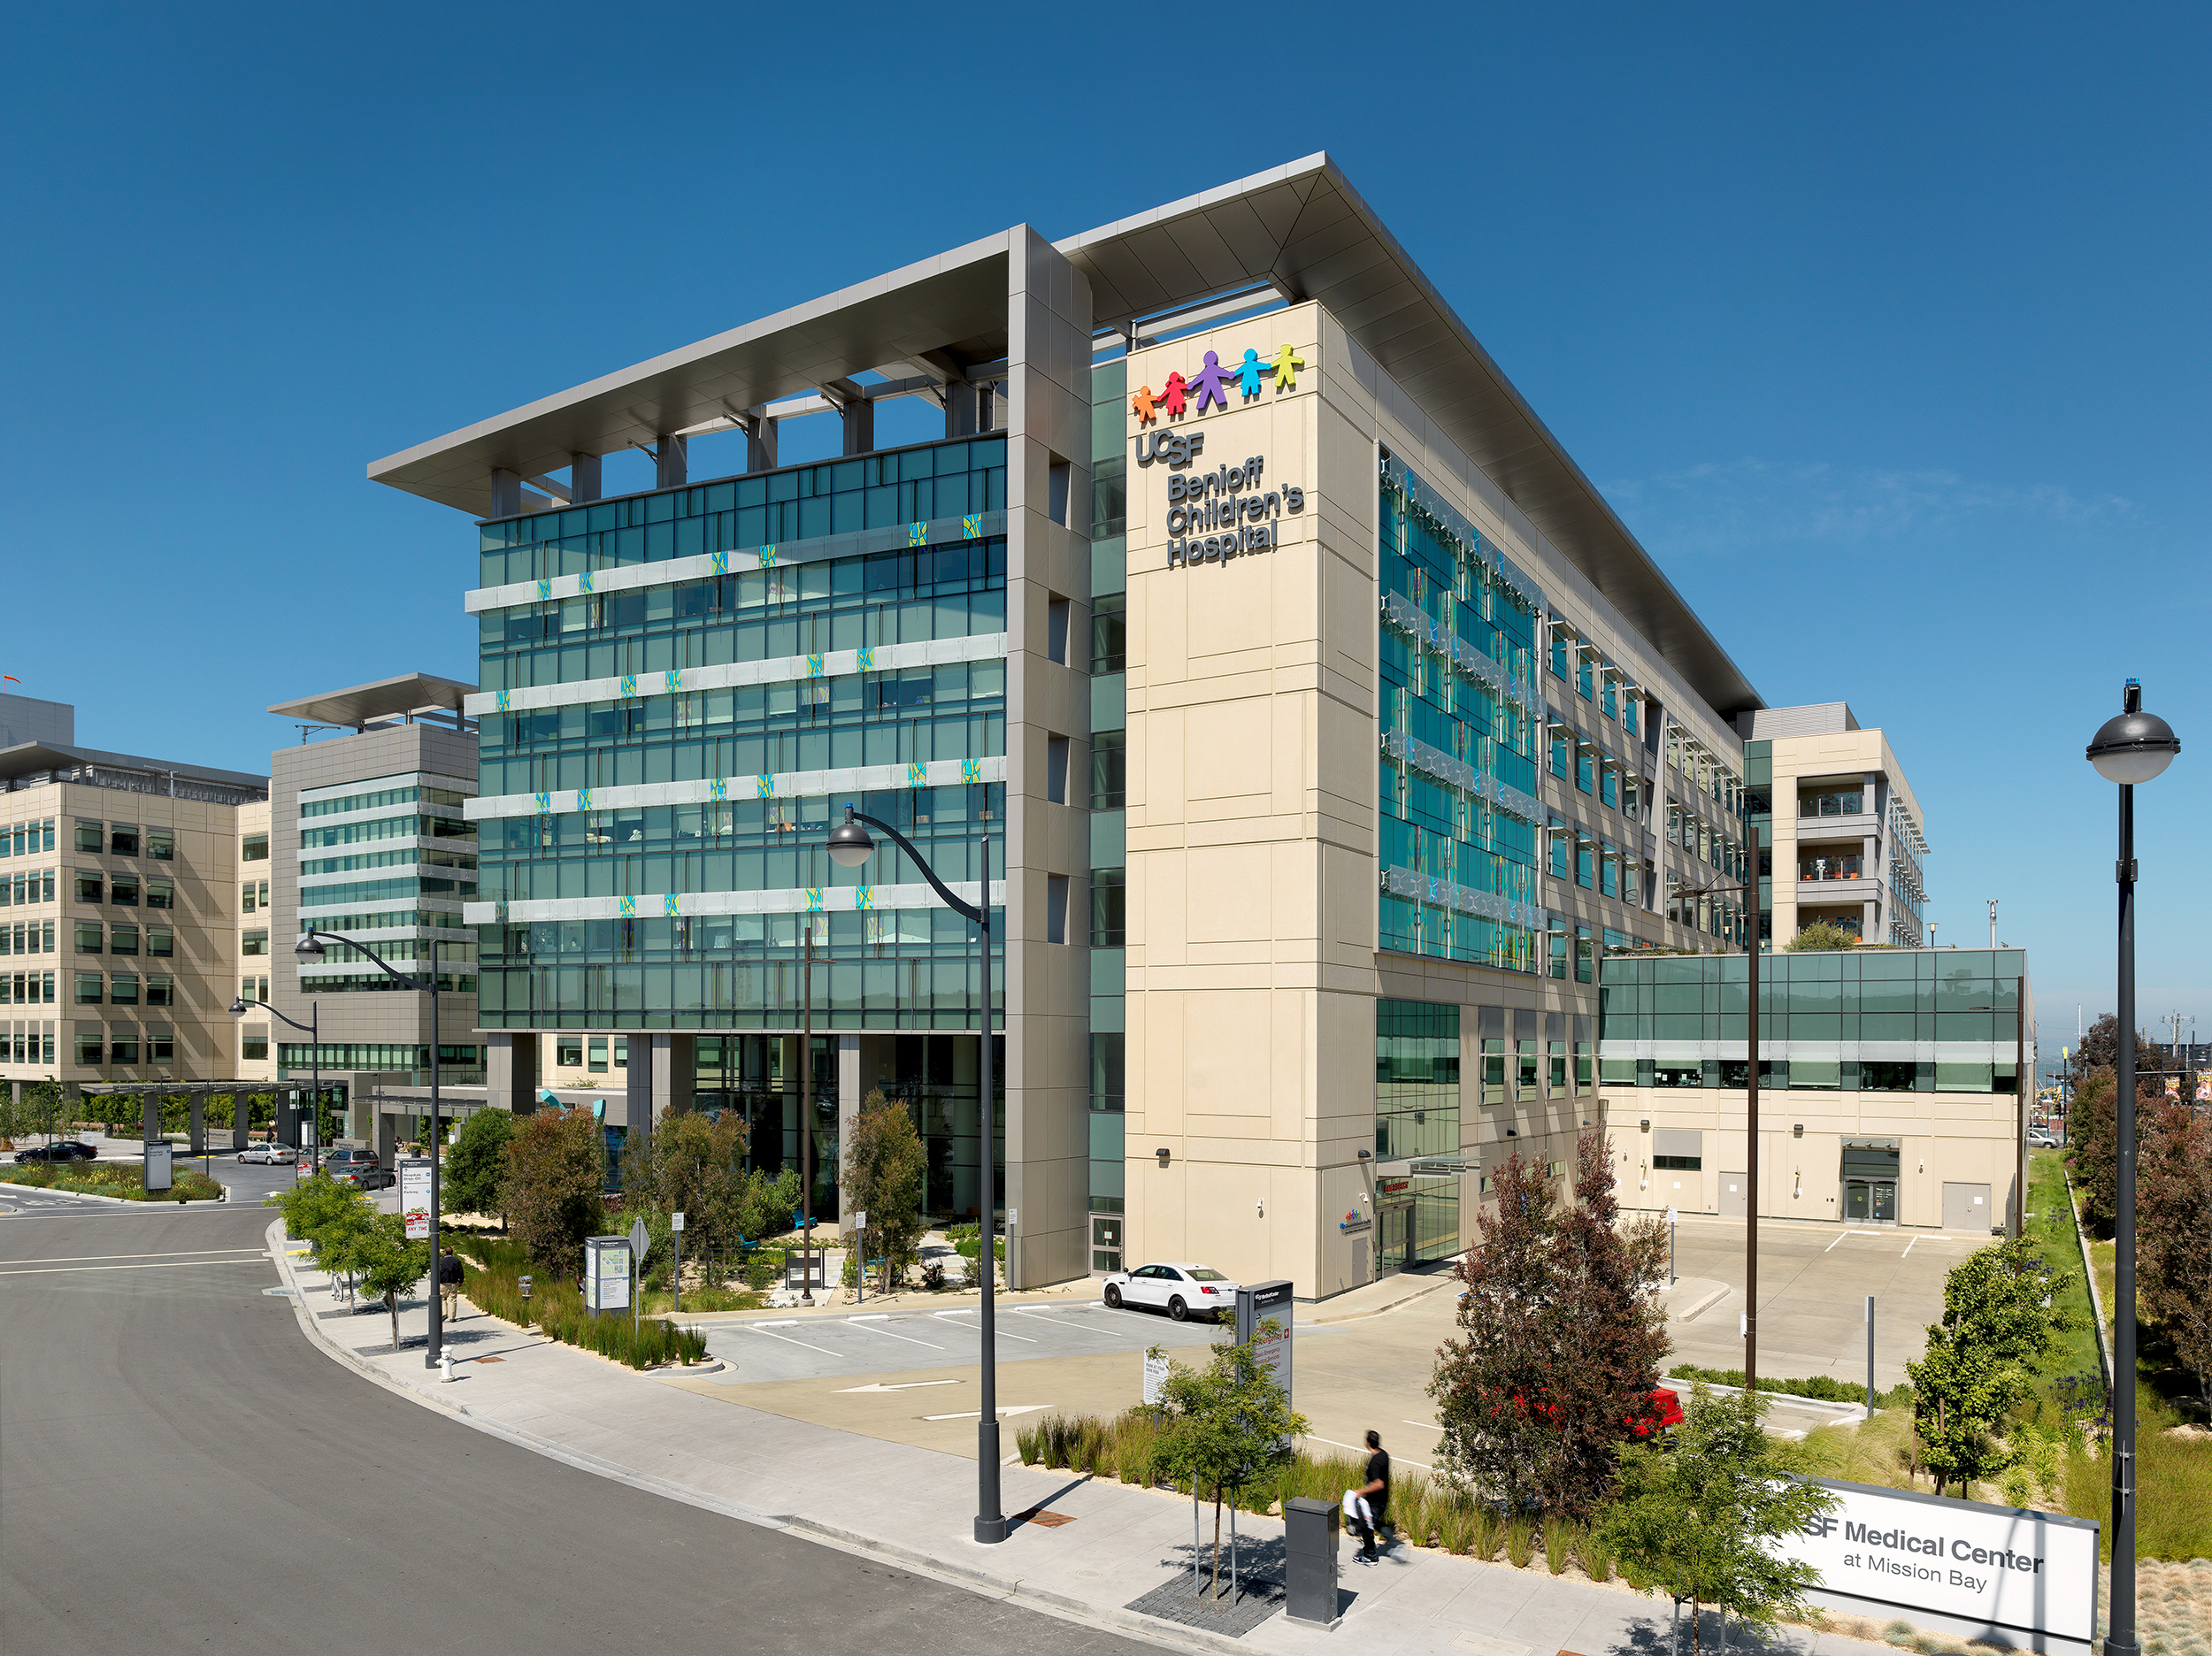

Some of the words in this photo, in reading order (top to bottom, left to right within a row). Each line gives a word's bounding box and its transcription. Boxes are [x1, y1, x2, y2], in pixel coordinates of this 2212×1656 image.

[1136, 429, 1204, 465] UCSF
[1168, 456, 1264, 502] Benioff
[1166, 483, 1304, 533] Children's
[1167, 518, 1278, 563] Hospital
[1384, 1181, 1409, 1193] EMERGENCY
[1845, 1521, 1945, 1557] Medical
[1951, 1539, 2045, 1574] Center
[1844, 1553, 1862, 1568] at
[1868, 1554, 1941, 1583] Mission
[1949, 1569, 1988, 1594] Bay
